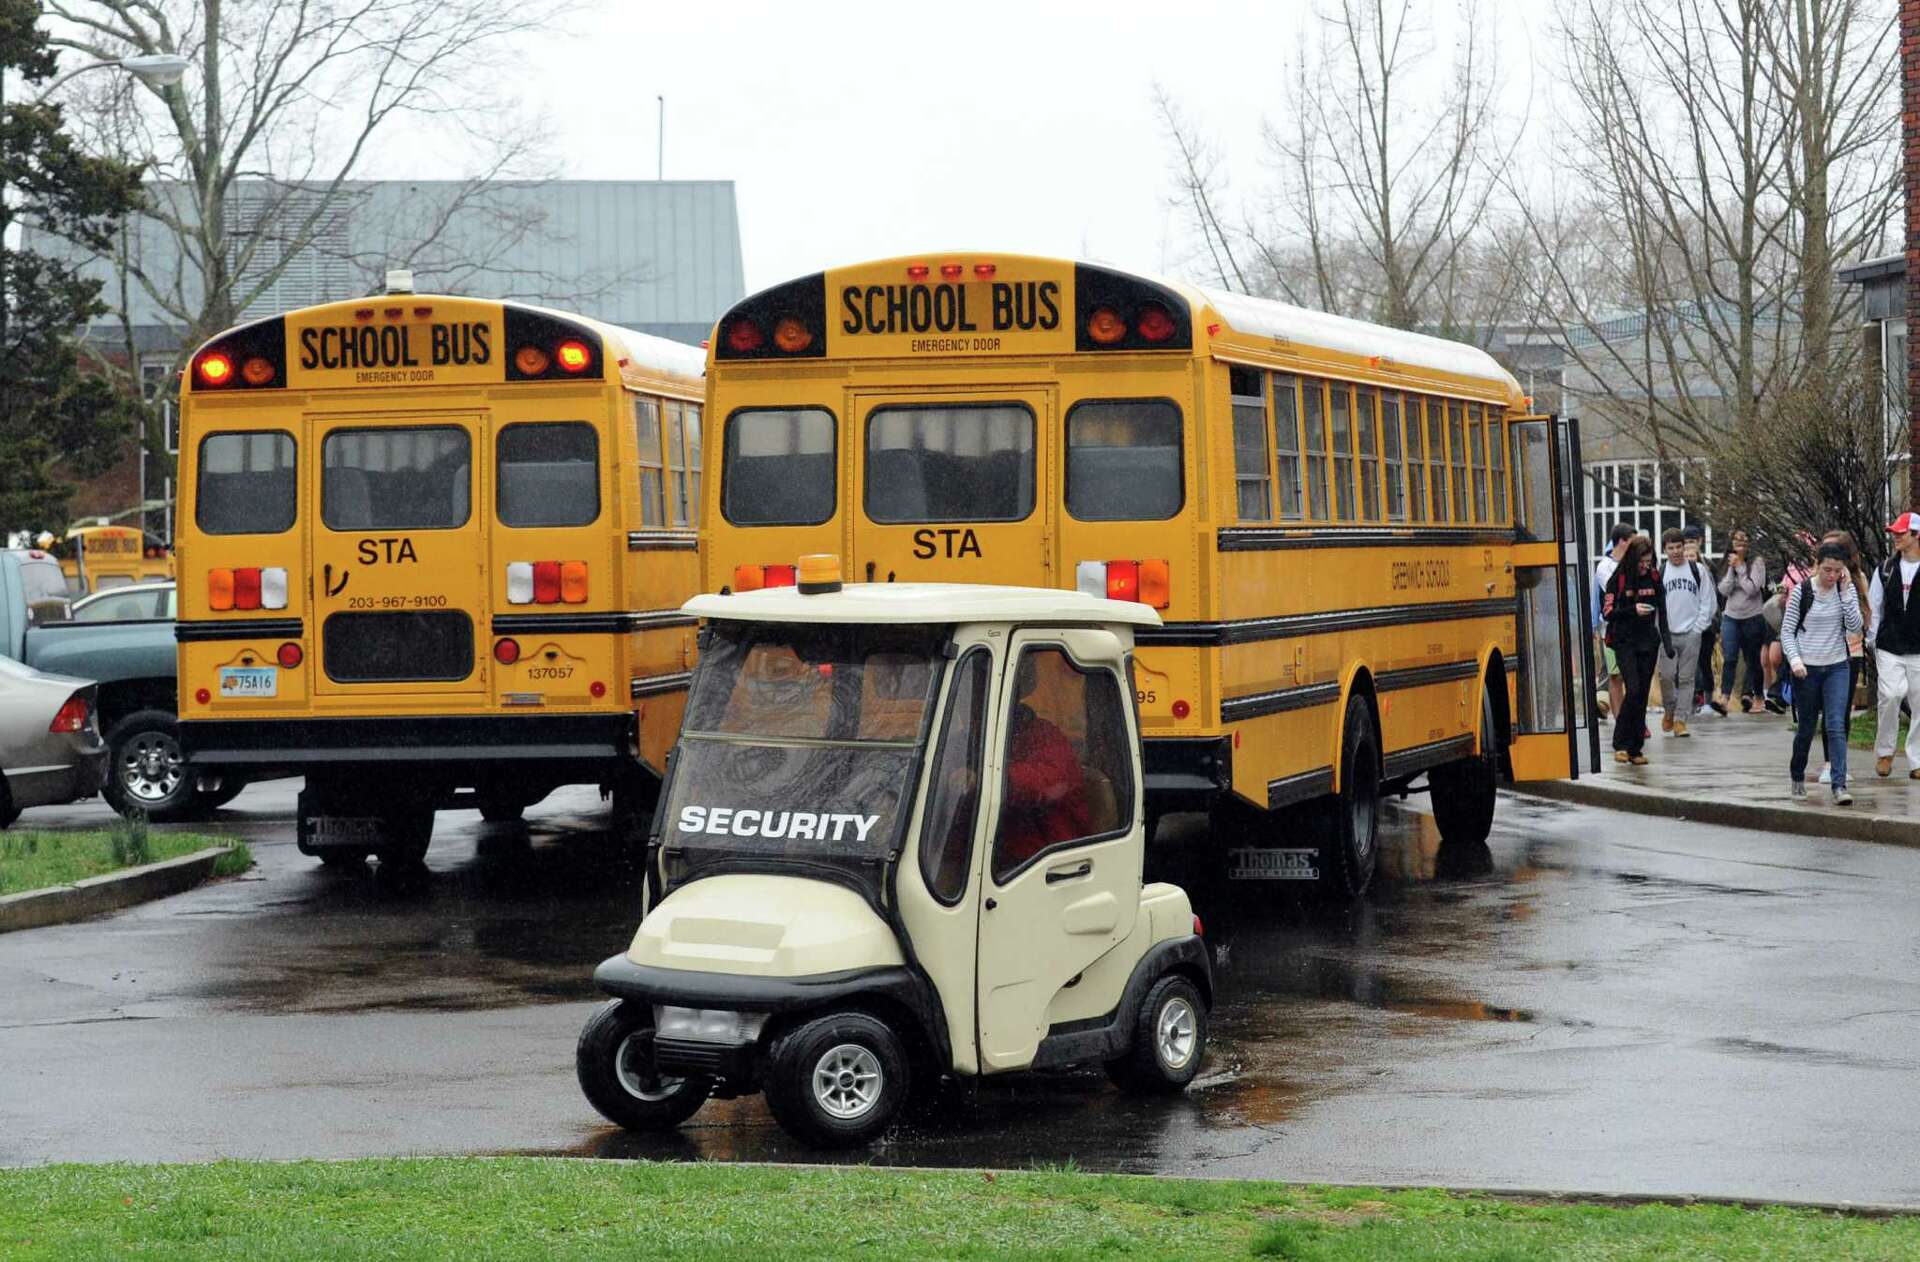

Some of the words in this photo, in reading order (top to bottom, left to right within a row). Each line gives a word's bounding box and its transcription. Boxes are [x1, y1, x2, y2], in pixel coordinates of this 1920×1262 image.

[843, 284, 976, 334] SCHOOL
[992, 282, 1060, 331] BUS
[301, 325, 418, 369] SCHOOL
[432, 323, 490, 365] BUS
[911, 339, 970, 352] EMERGENCY
[973, 338, 1000, 351] DOOR
[356, 371, 407, 383] EMERGENCY
[410, 370, 434, 382] DOOR
[357, 538, 418, 565] STA
[912, 528, 982, 560] STA
[348, 595, 447, 608] 203-967-9100
[528, 667, 574, 680] 137057
[678, 805, 880, 841] SECURITY
[1228, 848, 1318, 868] Thomas
